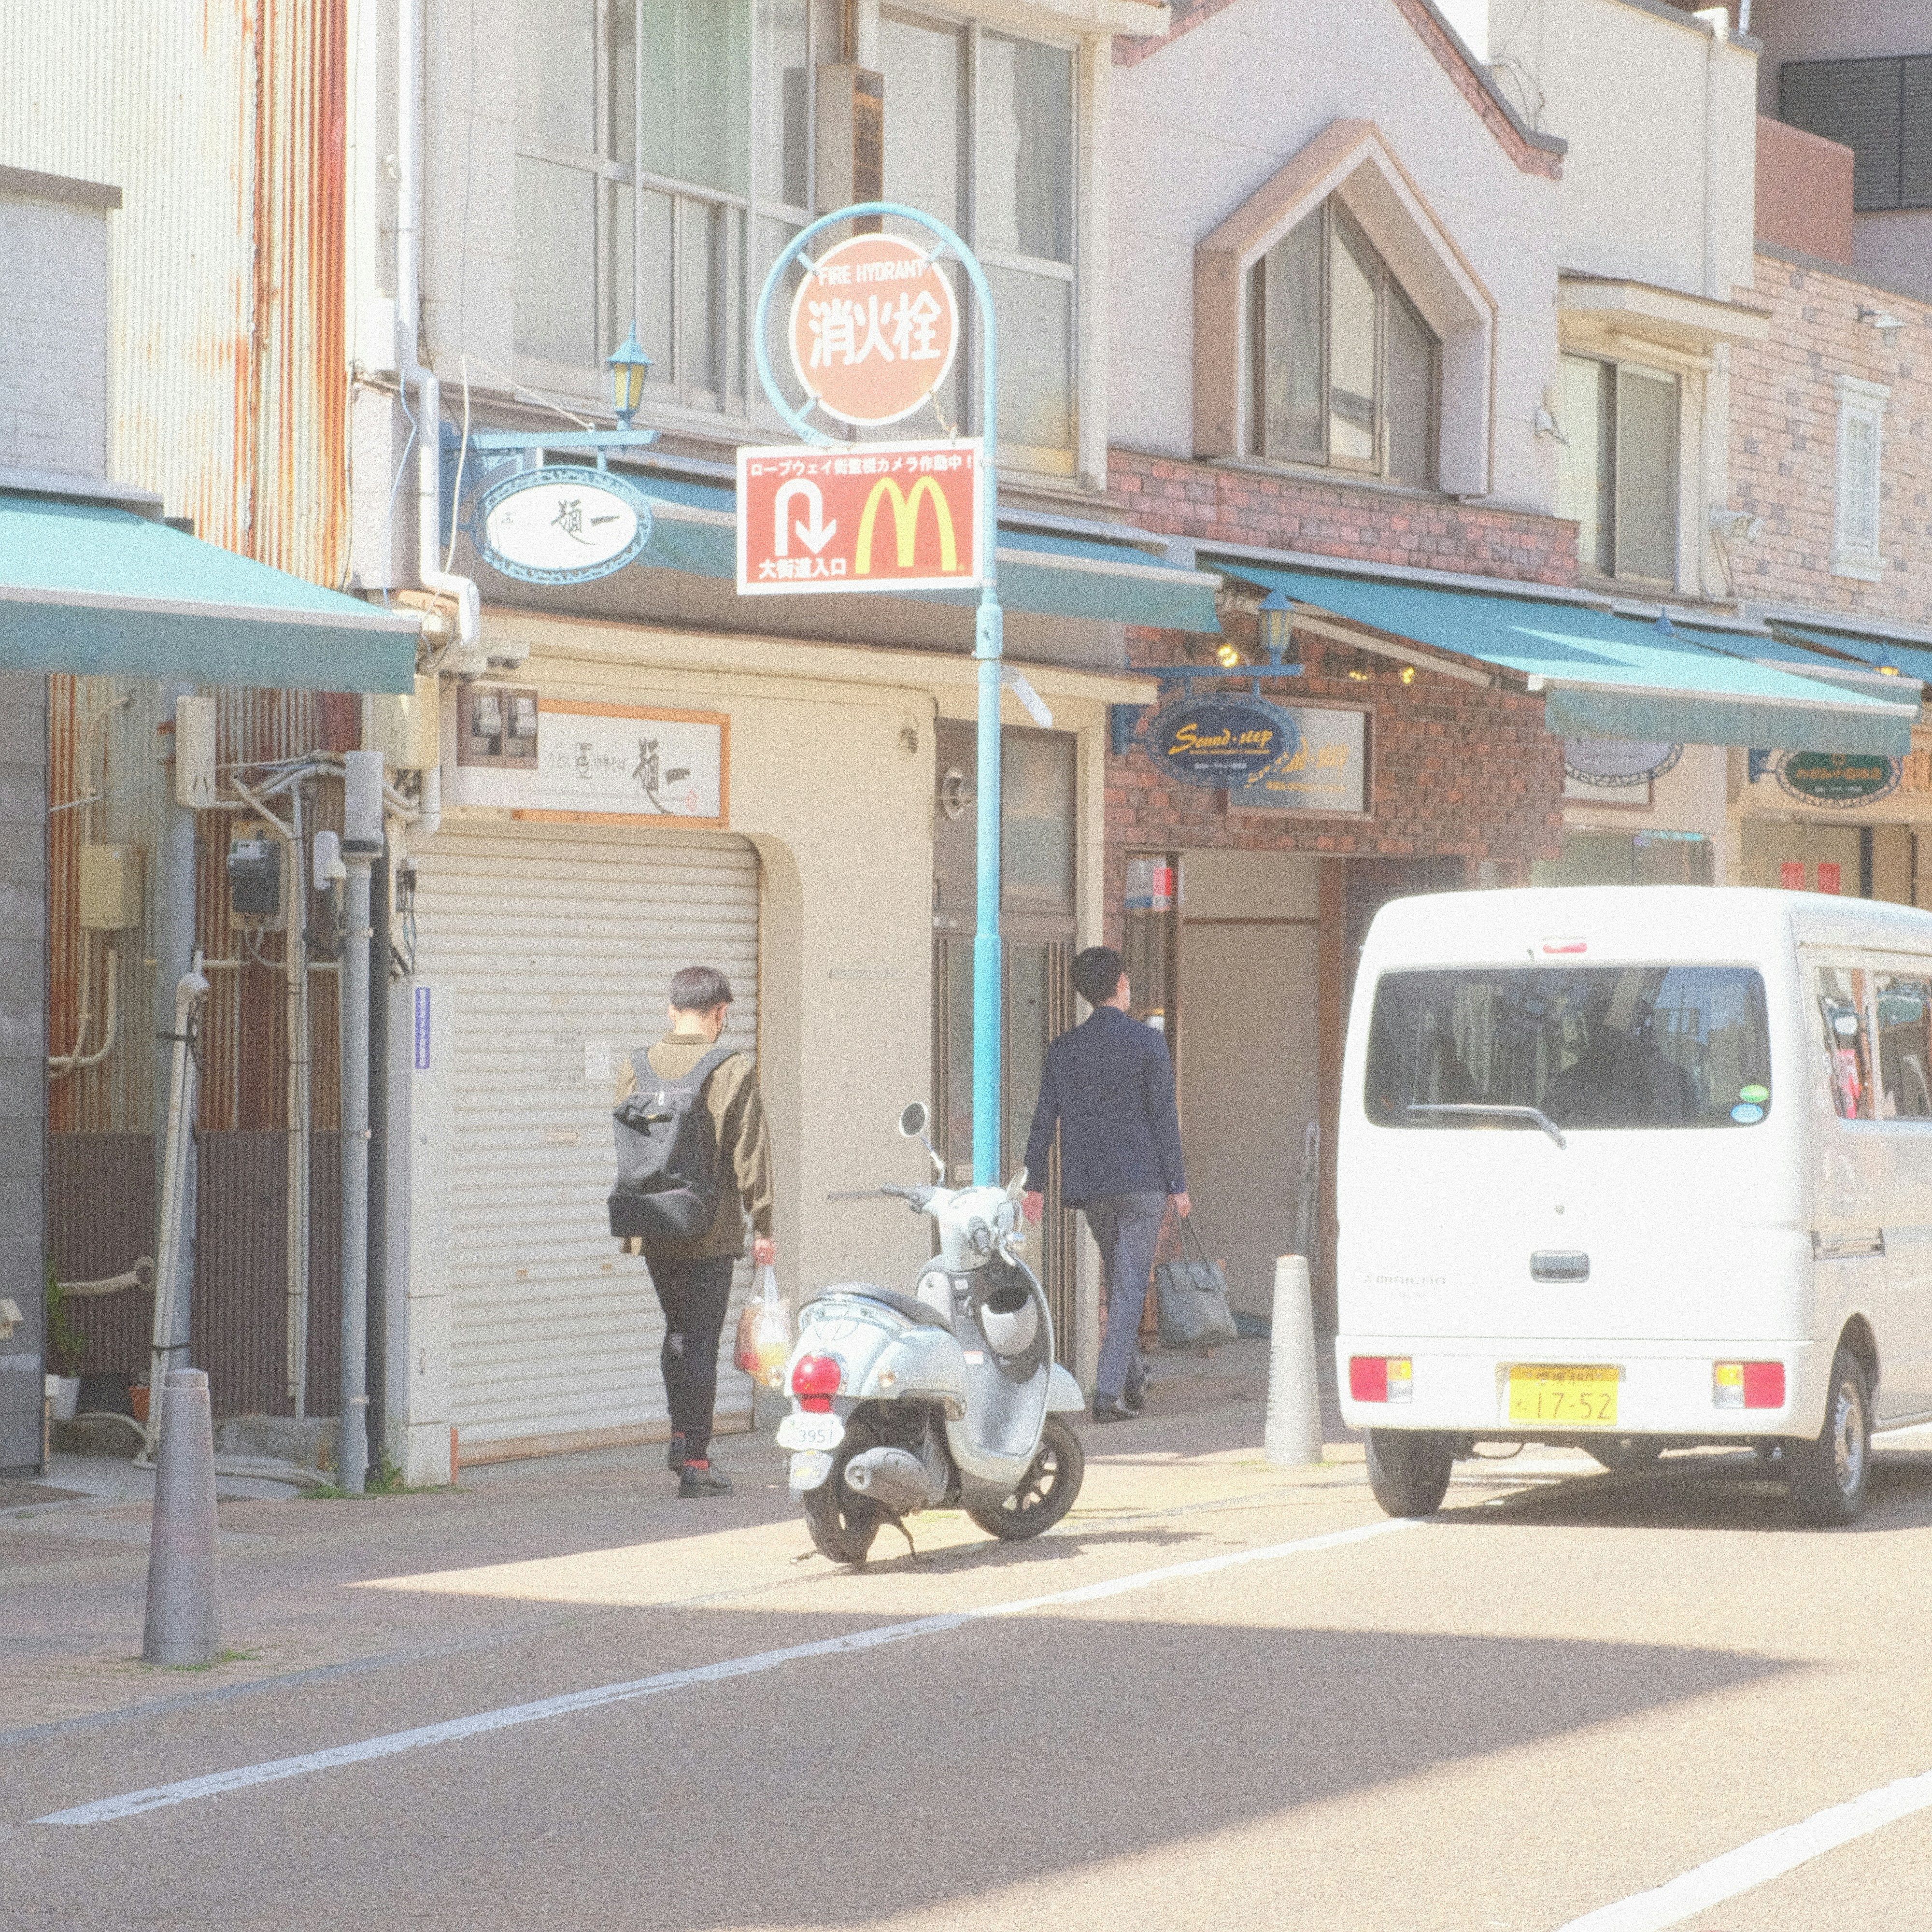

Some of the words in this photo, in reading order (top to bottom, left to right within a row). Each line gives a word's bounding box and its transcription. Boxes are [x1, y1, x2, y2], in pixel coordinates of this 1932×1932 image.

[818, 264, 852, 286] FIRE
[856, 259, 924, 283] HYDRANT
[808, 290, 942, 368] 消火栓
[759, 556, 846, 580] 大街道入口
[1537, 1391, 1612, 1421] 17-52
[798, 1429, 833, 1443] 3951
